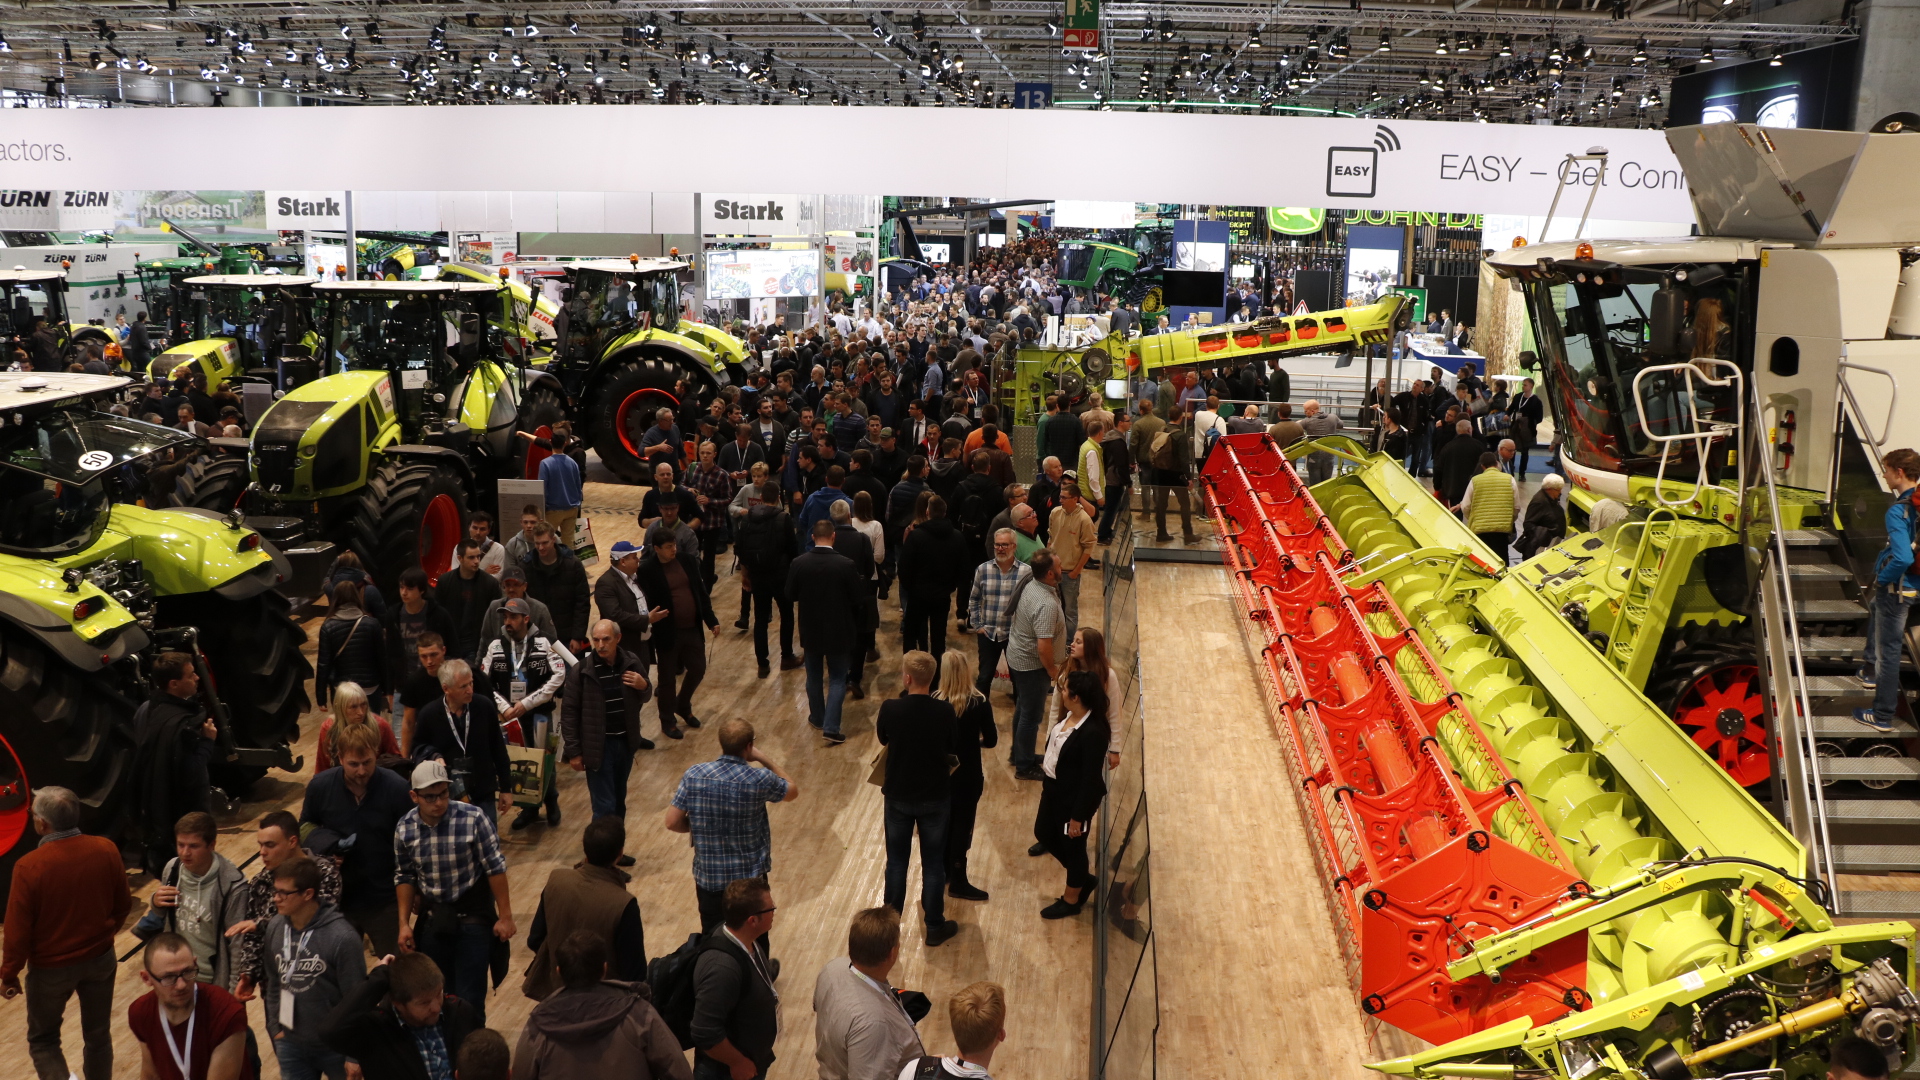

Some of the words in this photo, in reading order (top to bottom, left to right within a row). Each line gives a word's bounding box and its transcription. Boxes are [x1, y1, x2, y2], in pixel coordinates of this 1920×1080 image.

[1021, 90, 1045, 109] 13
[0, 139, 71, 161] actors.
[1334, 165, 1370, 176] EASY
[1439, 153, 1522, 183] EASY
[1557, 157, 1608, 187] Get
[0, 190, 51, 207] ÜRN
[63, 190, 109, 207] ZÜRN
[277, 196, 340, 217] Stark
[714, 199, 784, 221] Stark
[1205, 209, 1226, 217] JHN
[1344, 209, 1439, 227] JOHN
[1446, 213, 1484, 230] DE
[84, 253, 107, 263] ZÜRN
[711, 254, 736, 263] Stark
[532, 311, 555, 328] CLAA
[83, 453, 108, 467] 50
